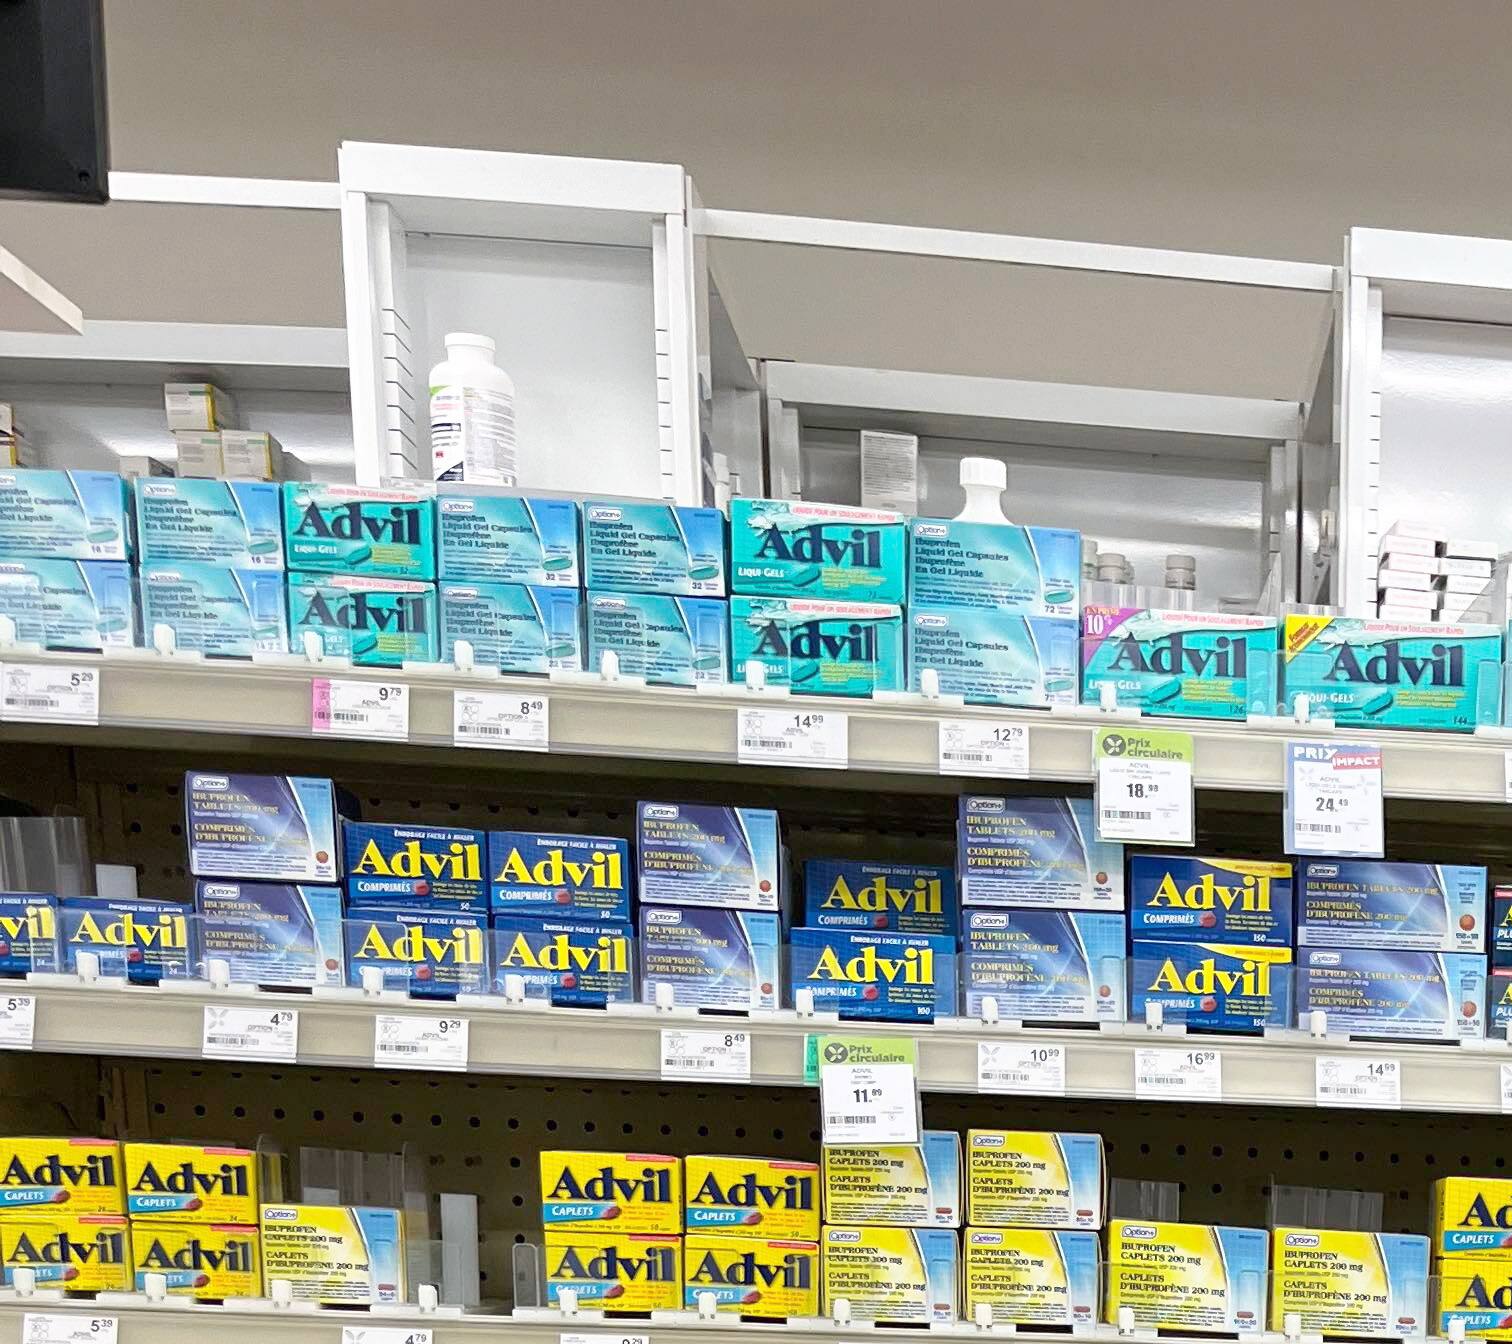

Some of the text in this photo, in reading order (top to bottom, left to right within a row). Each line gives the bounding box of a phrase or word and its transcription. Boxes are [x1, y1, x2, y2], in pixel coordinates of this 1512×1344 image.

[298, 501, 422, 544] Advil
[754, 520, 882, 569] Advil
[754, 615, 880, 662] Advil
[1323, 639, 1465, 687] Advil
[1127, 737, 1152, 749] Prix
[1127, 747, 1184, 760] circulaire
[1293, 745, 1337, 760] PRIX
[1332, 754, 1381, 769] IMPACT
[352, 838, 483, 881] Advil
[357, 880, 411, 893] COMPRIMÉS
[1146, 872, 1272, 912] Advil
[826, 875, 944, 914] Advil
[817, 913, 869, 927] COMPRIMÉS
[1143, 912, 1195, 926] COMPRIMÉS
[1147, 956, 1271, 996] Advil
[848, 1043, 873, 1055] Prix
[848, 1051, 906, 1064] circulaire
[1, 1153, 116, 1188] Advil
[126, 1162, 248, 1196] Advil
[551, 1165, 671, 1203] Advil
[3, 1190, 45, 1202] CAPLETS
[135, 1197, 177, 1209] CAPLETS
[693, 1210, 736, 1222] CAPLETS
[1451, 1232, 1495, 1245] CAPLETS
[1120, 1242, 1176, 1254] IBUPROFEN
[1119, 1252, 1202, 1267] CAPLETS 200 mg
[1119, 1272, 1165, 1284] CAPLETS
[1192, 1287, 1210, 1297] 200
[1212, 1289, 1226, 1299] mg
